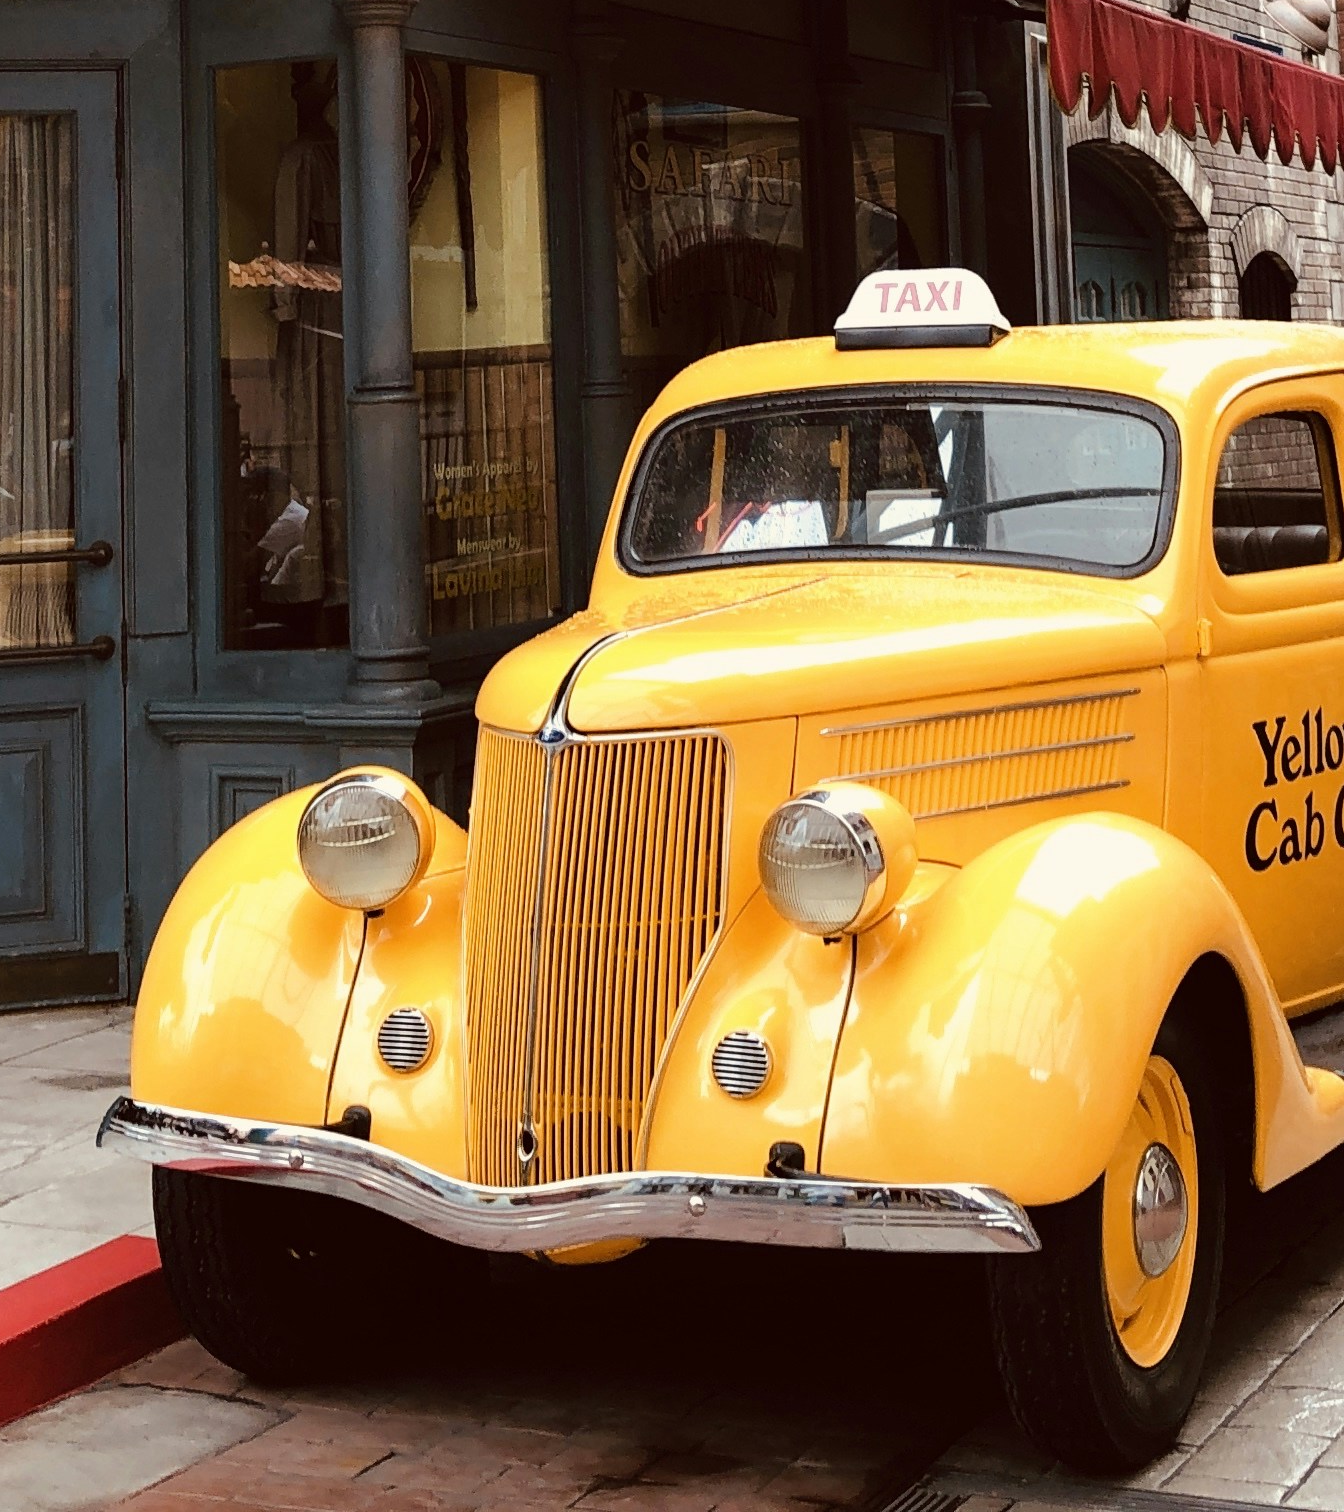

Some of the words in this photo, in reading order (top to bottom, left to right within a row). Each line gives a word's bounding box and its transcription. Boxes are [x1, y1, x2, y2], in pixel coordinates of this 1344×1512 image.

[629, 141, 793, 207] SAFARI
[874, 280, 963, 314] TAXI
[433, 459, 480, 481] Women's
[526, 456, 538, 475] by
[508, 532, 521, 552] by
[1245, 790, 1325, 872] Cab
